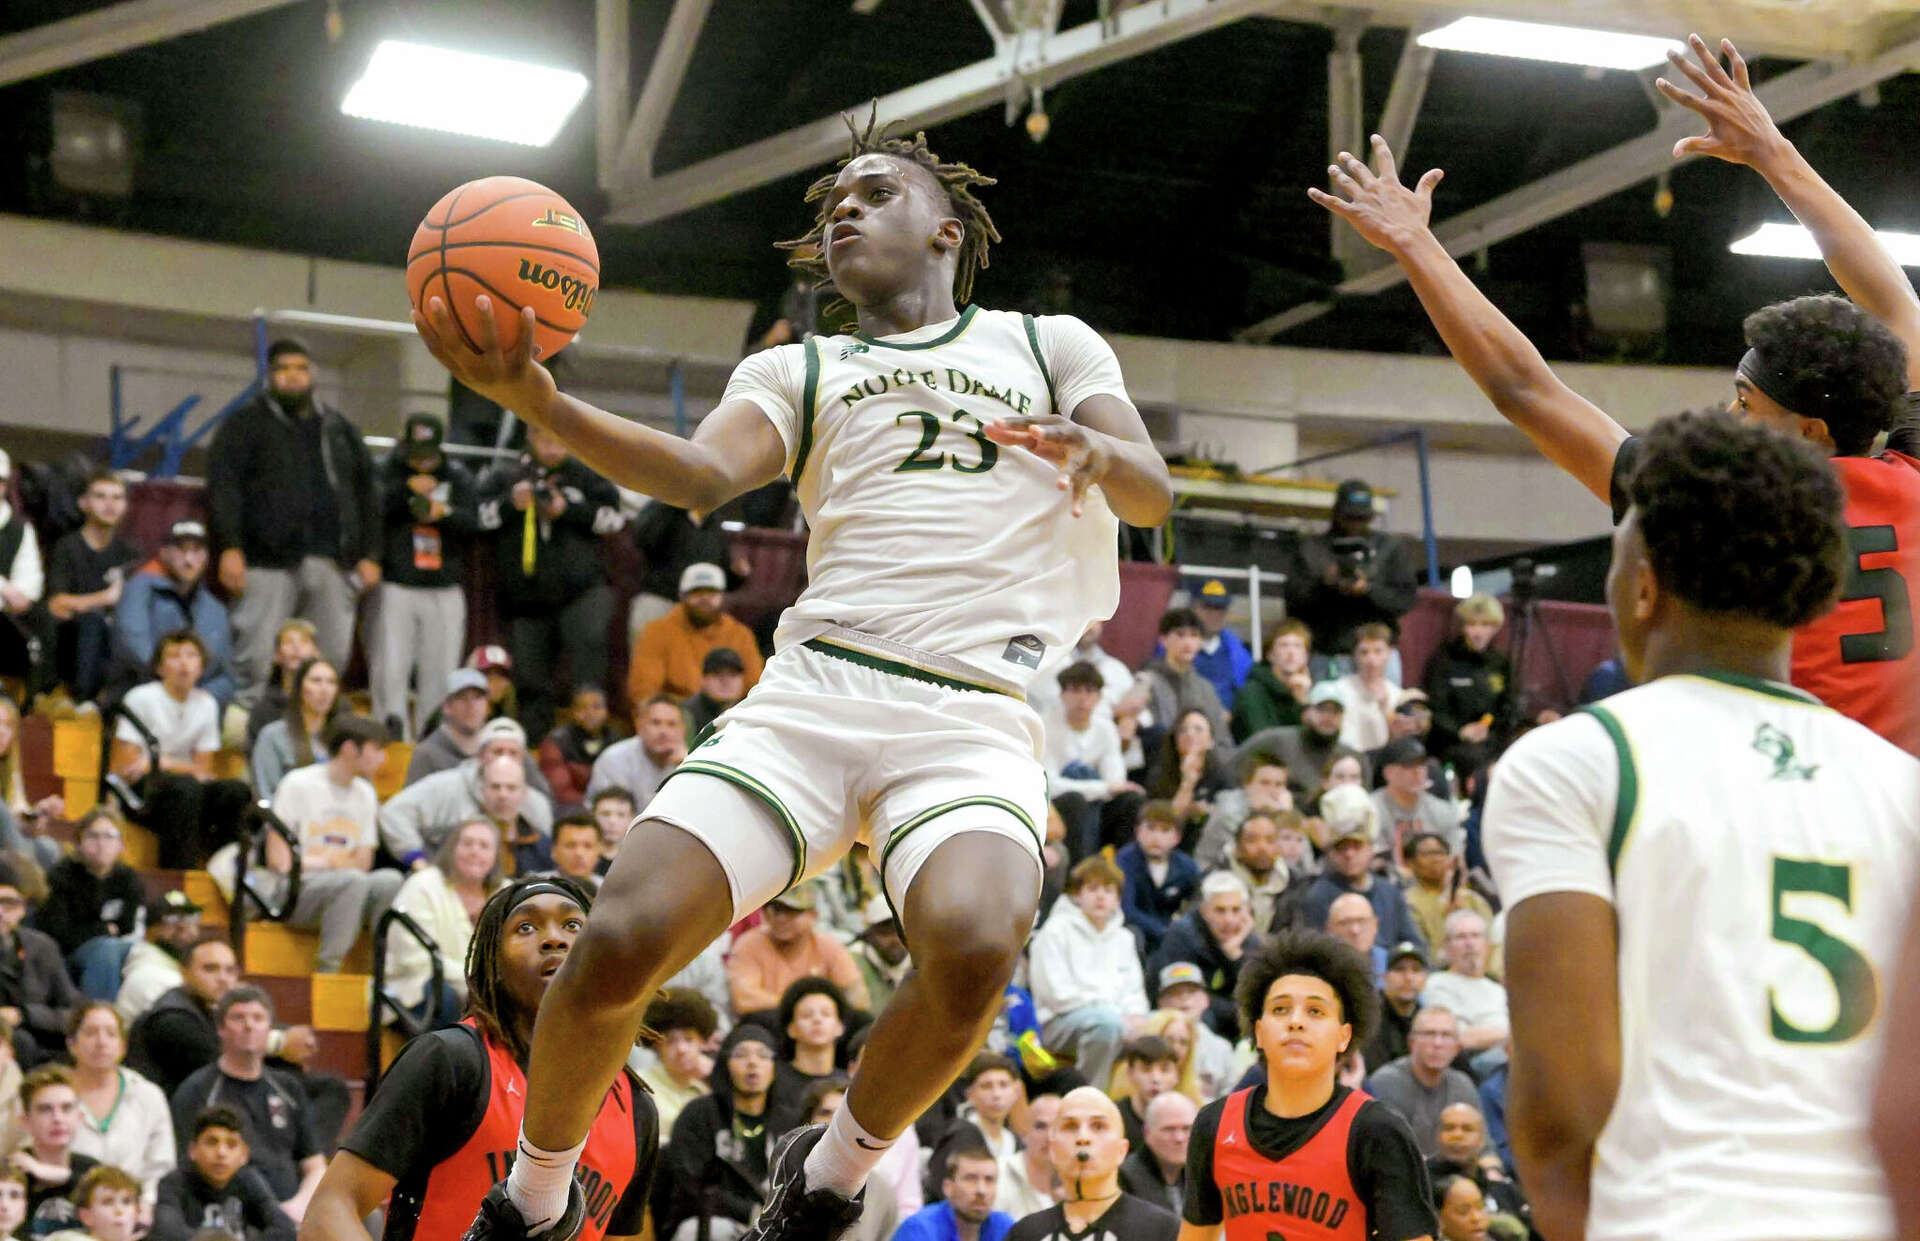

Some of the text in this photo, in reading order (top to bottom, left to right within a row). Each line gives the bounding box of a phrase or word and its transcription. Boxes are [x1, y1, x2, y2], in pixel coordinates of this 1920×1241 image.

[532, 208, 592, 241] ET
[894, 410, 999, 474] 23
[1838, 525, 1914, 664] 5
[1767, 855, 1881, 1045] 5
[1223, 1181, 1350, 1230] NGLEWOOD
